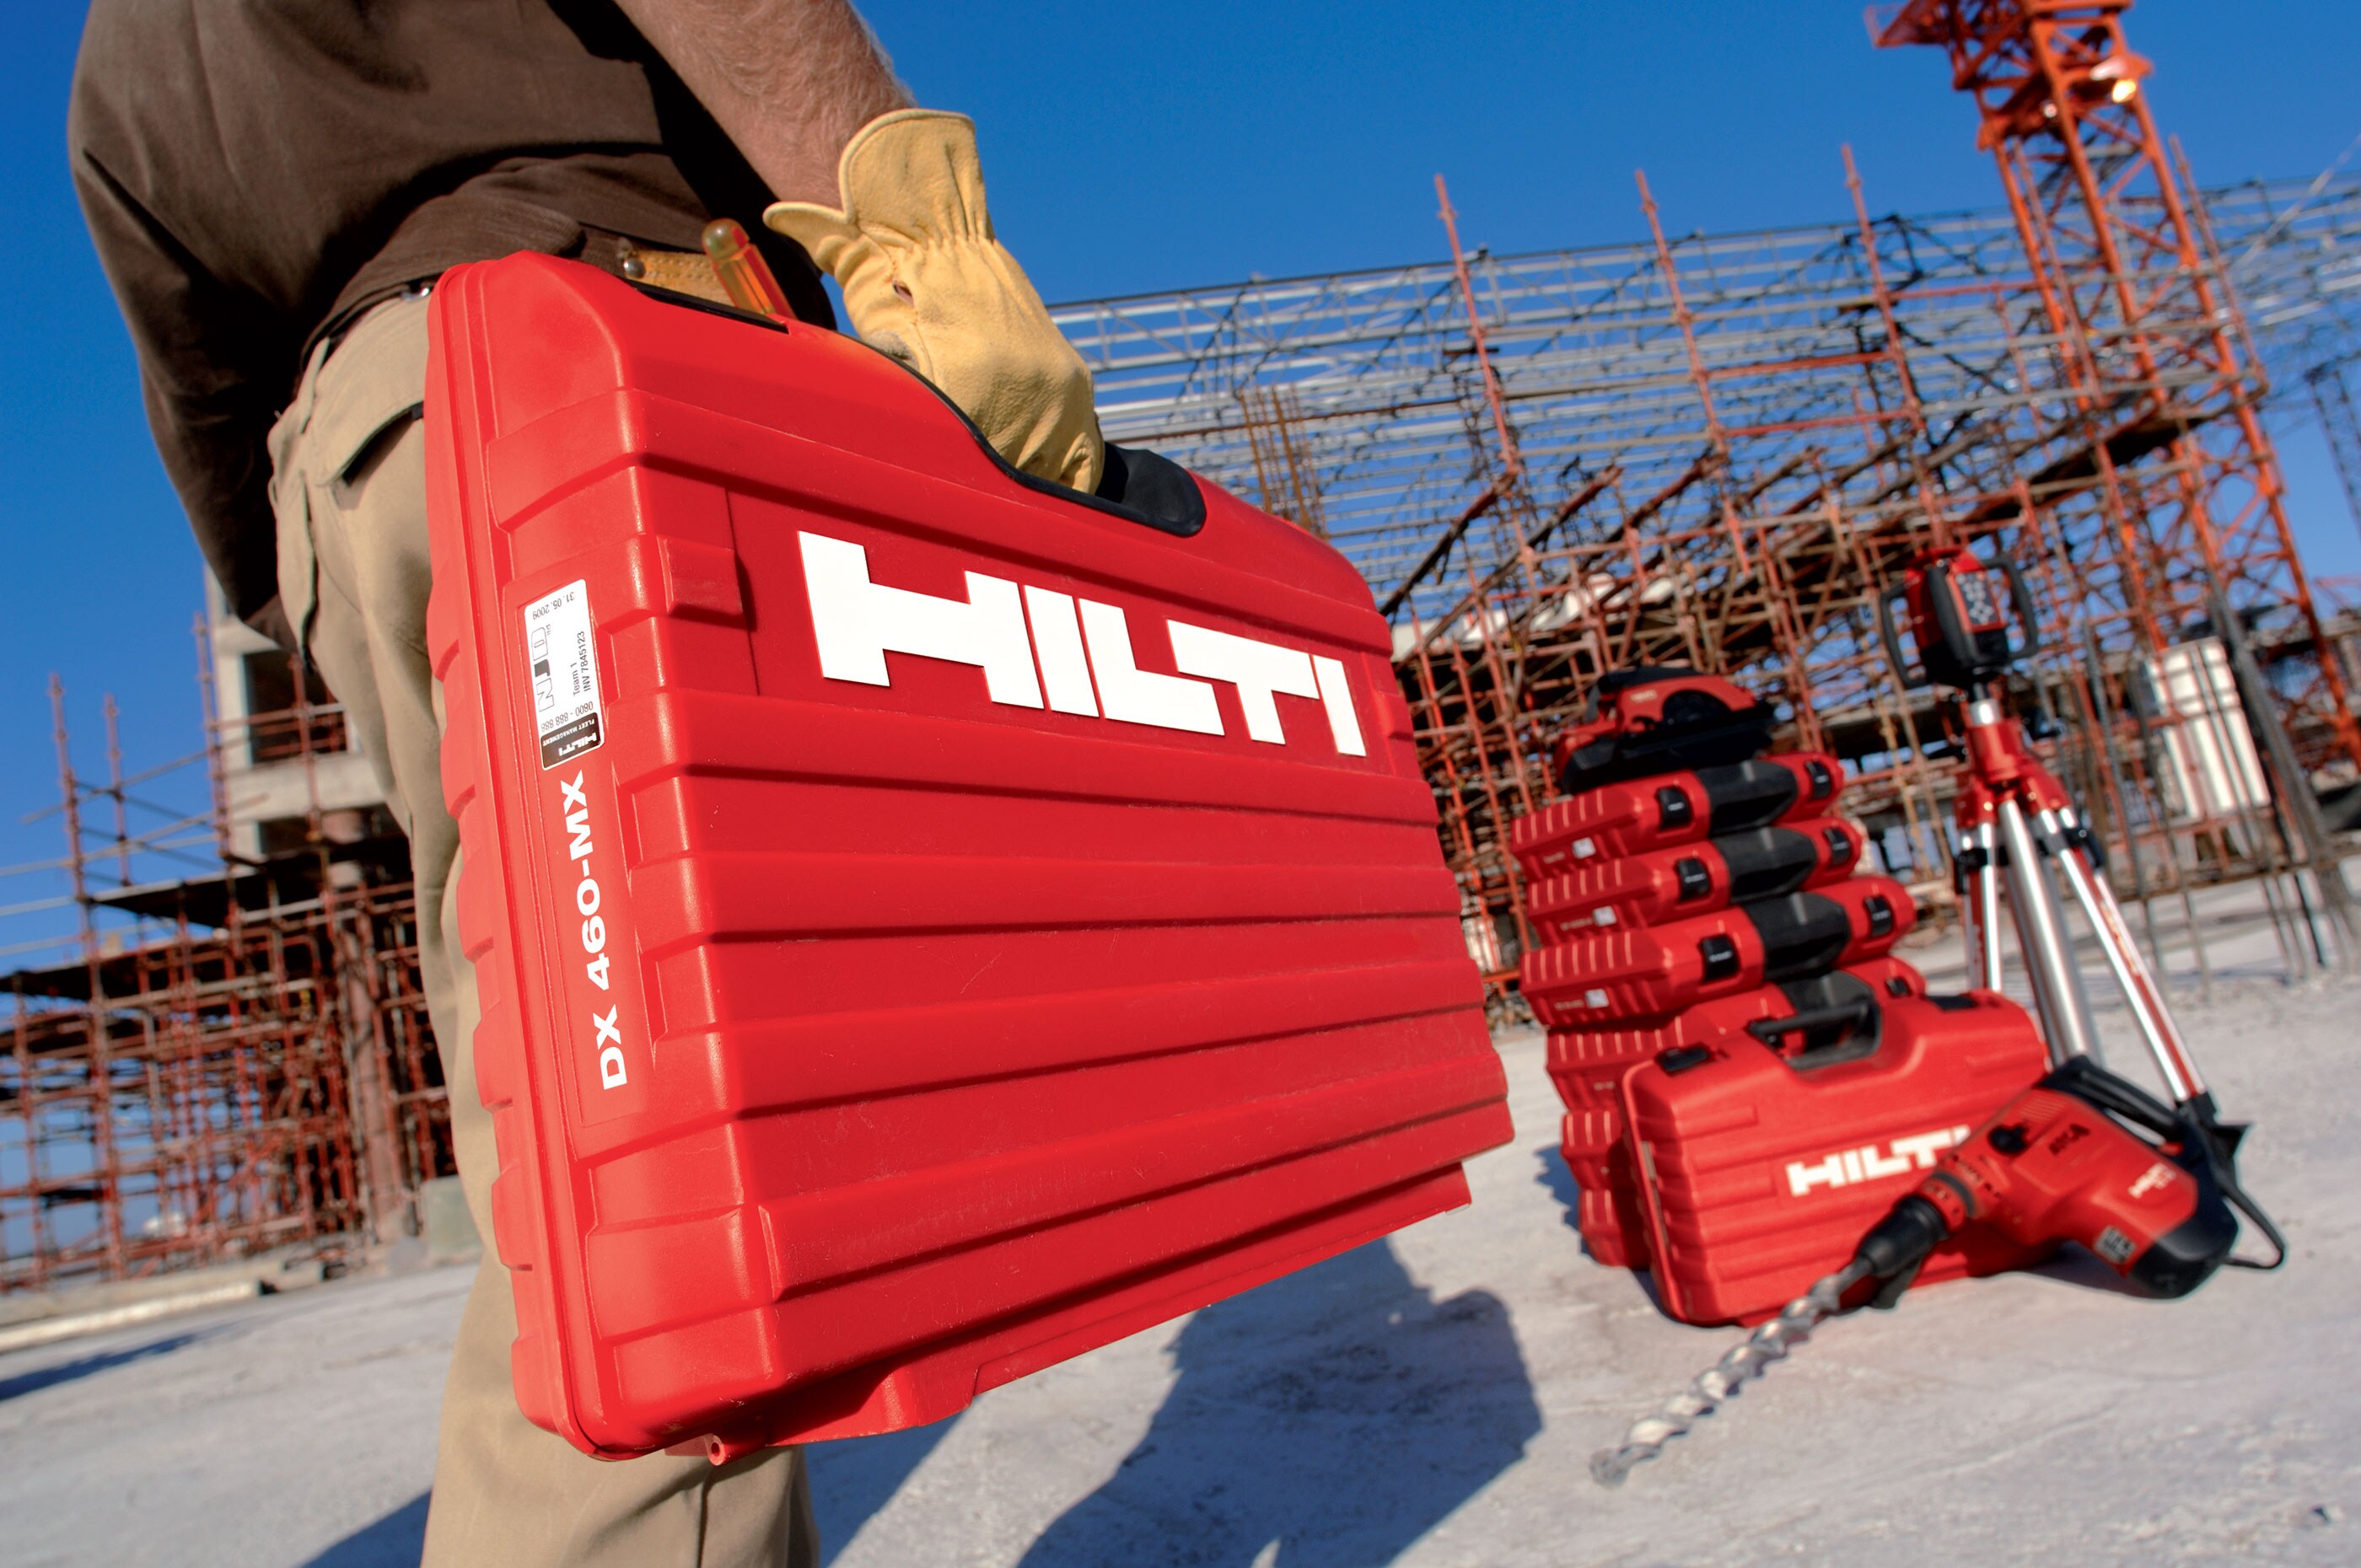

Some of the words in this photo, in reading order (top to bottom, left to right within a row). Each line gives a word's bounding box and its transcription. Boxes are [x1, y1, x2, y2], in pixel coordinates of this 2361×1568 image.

[532, 604, 550, 620] 2009
[577, 631, 589, 674] 7845123
[799, 531, 1366, 756] HILTI
[531, 626, 555, 712] NJD
[572, 670, 580, 697] Team
[582, 675, 591, 692] INV
[555, 712, 568, 726] 888
[575, 701, 594, 717] 0800
[541, 719, 554, 733] 888
[578, 719, 595, 731] FLEET
[542, 726, 578, 747] MANAGEMENT
[558, 733, 597, 756] HILTI
[561, 770, 610, 991] 460-MX
[593, 1003, 627, 1090] DX
